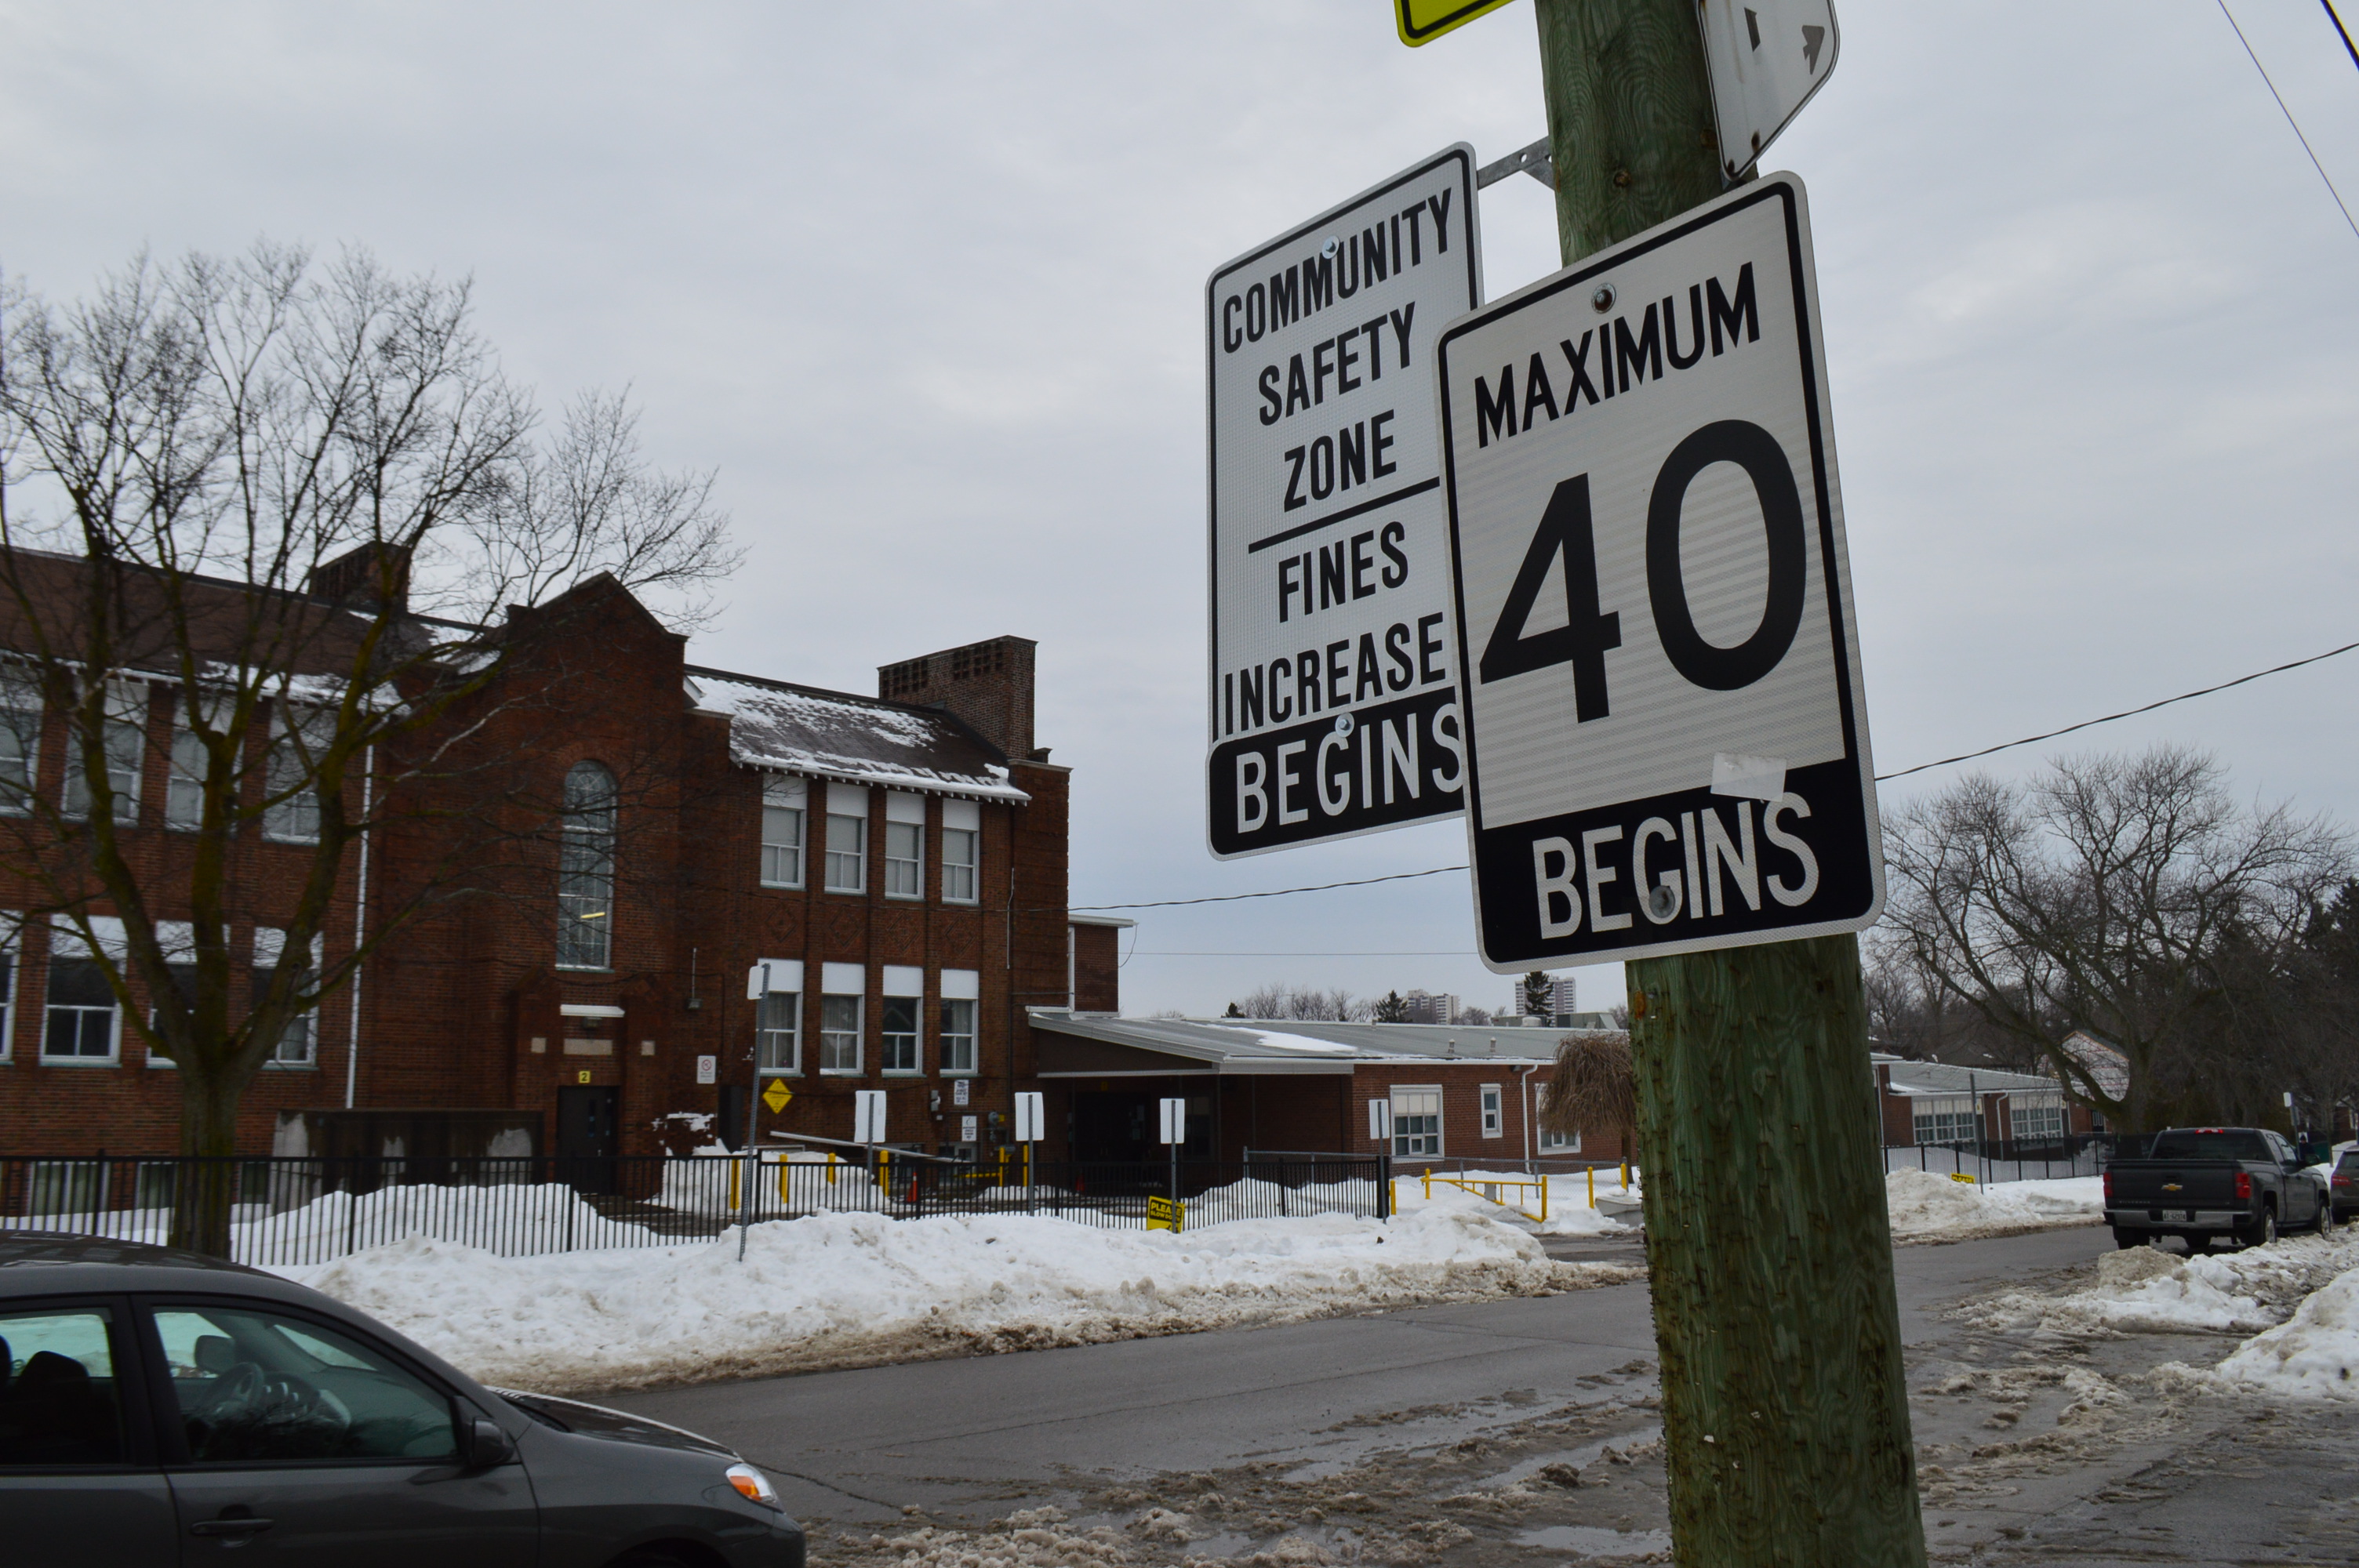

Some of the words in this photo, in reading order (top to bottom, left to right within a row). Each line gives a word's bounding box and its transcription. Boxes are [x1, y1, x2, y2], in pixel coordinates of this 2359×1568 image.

[1223, 187, 1451, 353] COMMUNITY
[1259, 301, 1415, 426] SAFETY
[1475, 262, 1760, 448] MAXIMUM
[1284, 409, 1396, 512] ZONE
[1279, 521, 1408, 622] FINES
[1480, 419, 1806, 723] 40
[1237, 703, 1463, 833] BEGINS
[1533, 792, 1819, 938] BEGINS
[581, 1073, 587, 1081] 2
[1151, 1202, 1181, 1216] PLEAE
